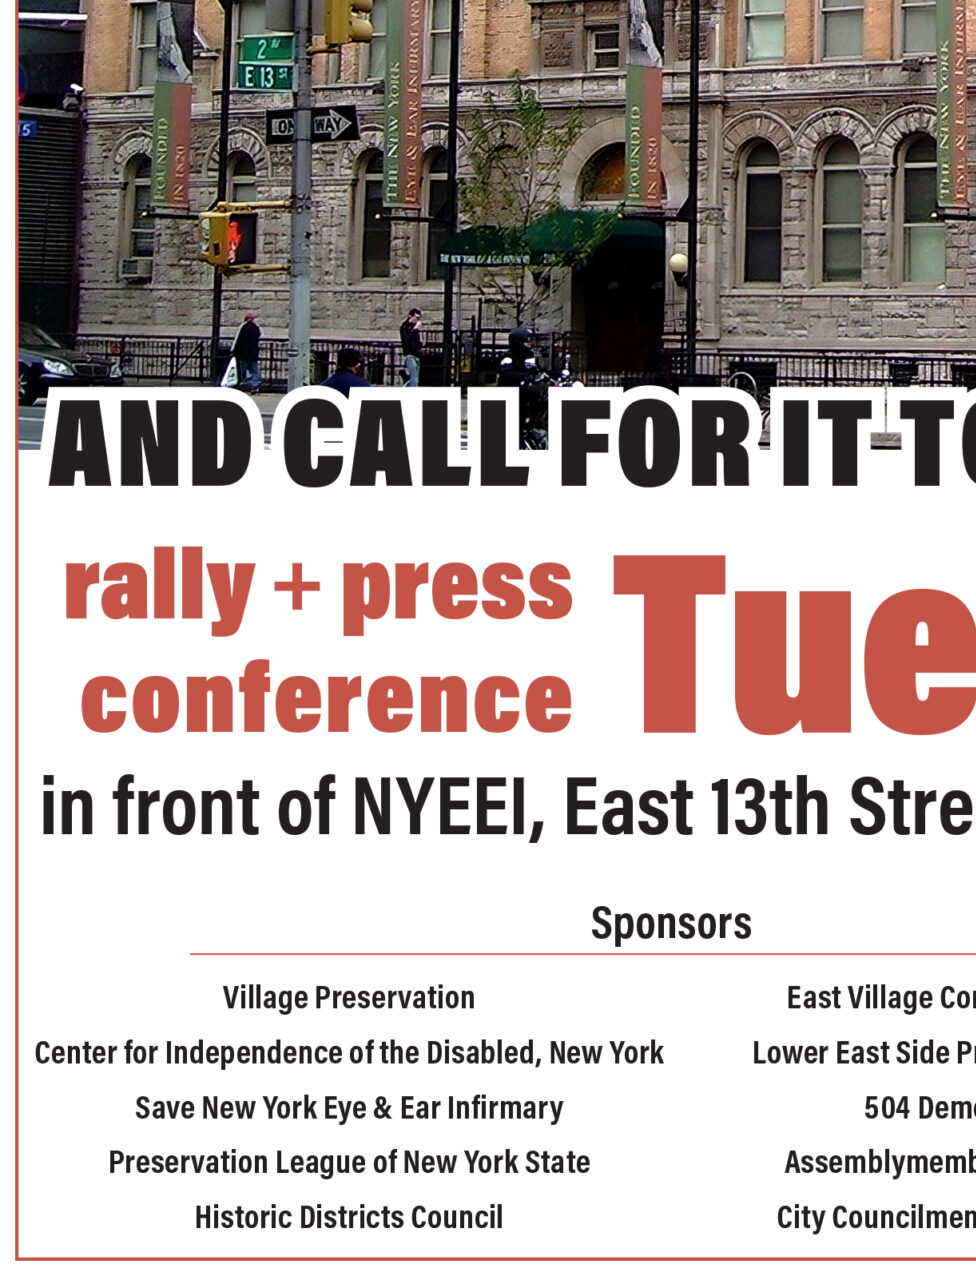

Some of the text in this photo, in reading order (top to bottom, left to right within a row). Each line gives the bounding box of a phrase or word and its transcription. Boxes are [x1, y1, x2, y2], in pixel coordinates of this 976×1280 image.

[257, 39, 267, 60] 2
[245, 66, 254, 87] E
[260, 67, 274, 88] 13
[387, 62, 401, 109] YORK
[627, 106, 642, 198] FOUNDED
